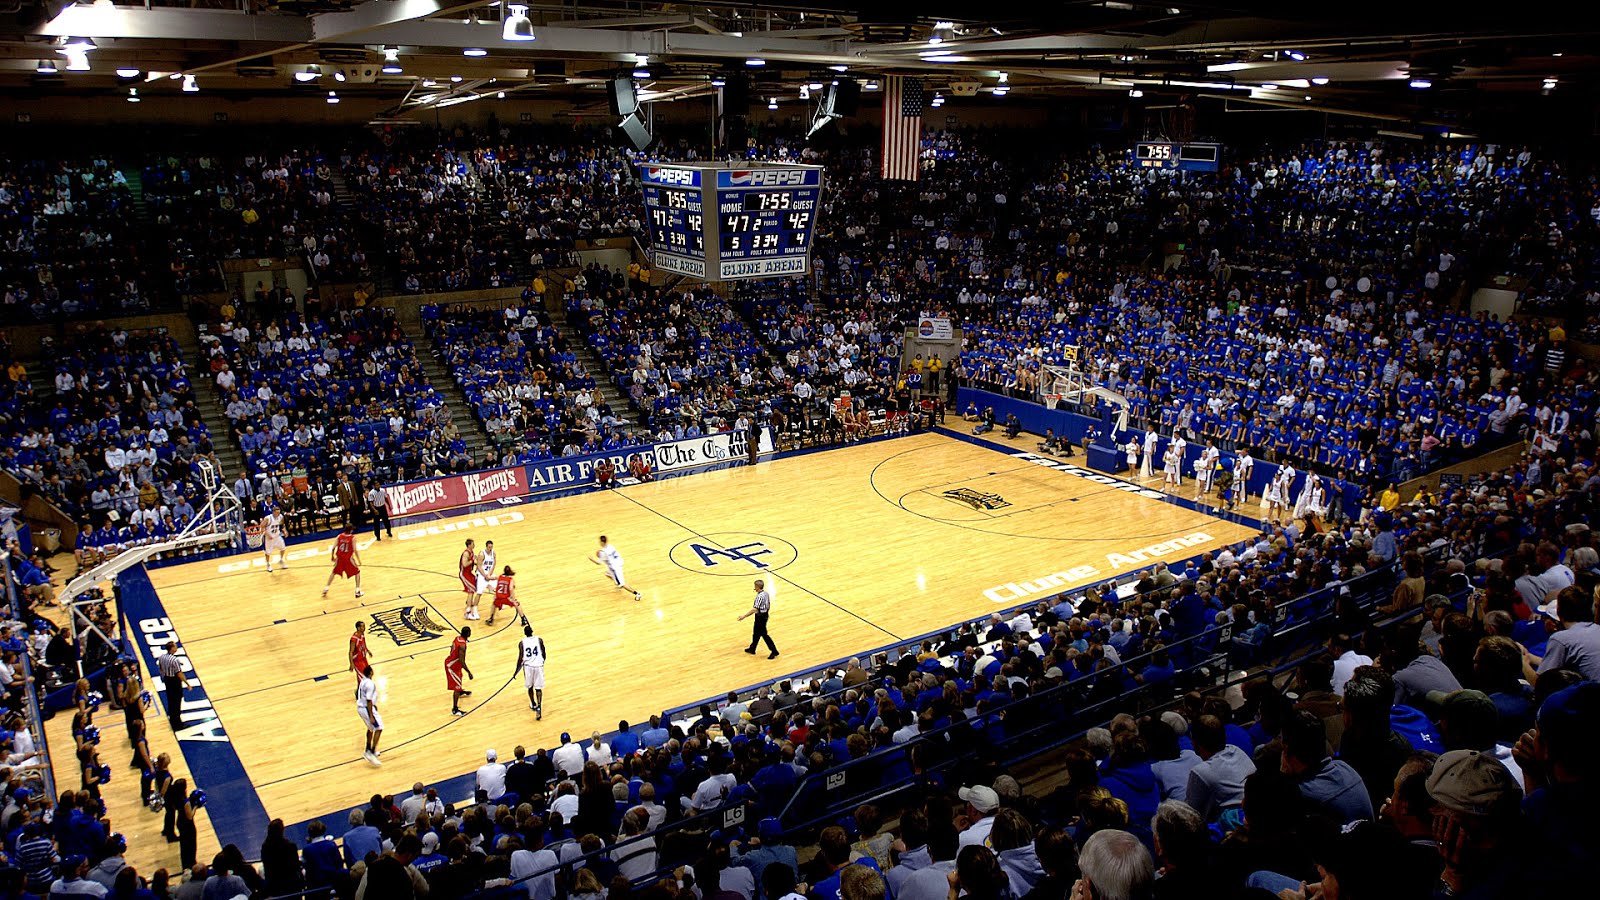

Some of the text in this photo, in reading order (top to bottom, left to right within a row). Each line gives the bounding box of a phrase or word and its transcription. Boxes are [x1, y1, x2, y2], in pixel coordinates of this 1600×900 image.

[1147, 145, 1170, 159] 7:55
[660, 168, 693, 184] PEPSI
[750, 170, 806, 186] PEPSI
[666, 191, 686, 208] 7:55
[758, 193, 790, 210] 7:55
[792, 200, 814, 210] GUEST
[720, 202, 742, 213] HOME
[654, 210, 666, 226] 47
[668, 215, 673, 227] 2
[688, 214, 701, 231] 42
[728, 216, 749, 232] 47
[753, 218, 761, 231] 2
[789, 212, 809, 229] 42
[659, 230, 664, 242] 5
[670, 232, 686, 245] 3 34
[697, 236, 702, 249] 4
[732, 237, 739, 249] 5
[753, 234, 778, 248] 3 34
[796, 233, 804, 245] 4
[680, 260, 703, 275] ARENA
[722, 259, 803, 276] CLUNE ARENA
[657, 443, 695, 466] The
[530, 463, 575, 488] AIR
[339, 543, 349, 553] 41
[690, 542, 773, 568] AF
[982, 532, 1215, 603] Clune Arena
[497, 584, 508, 594] 21
[525, 646, 538, 657] 34
[725, 808, 742, 822] L6
